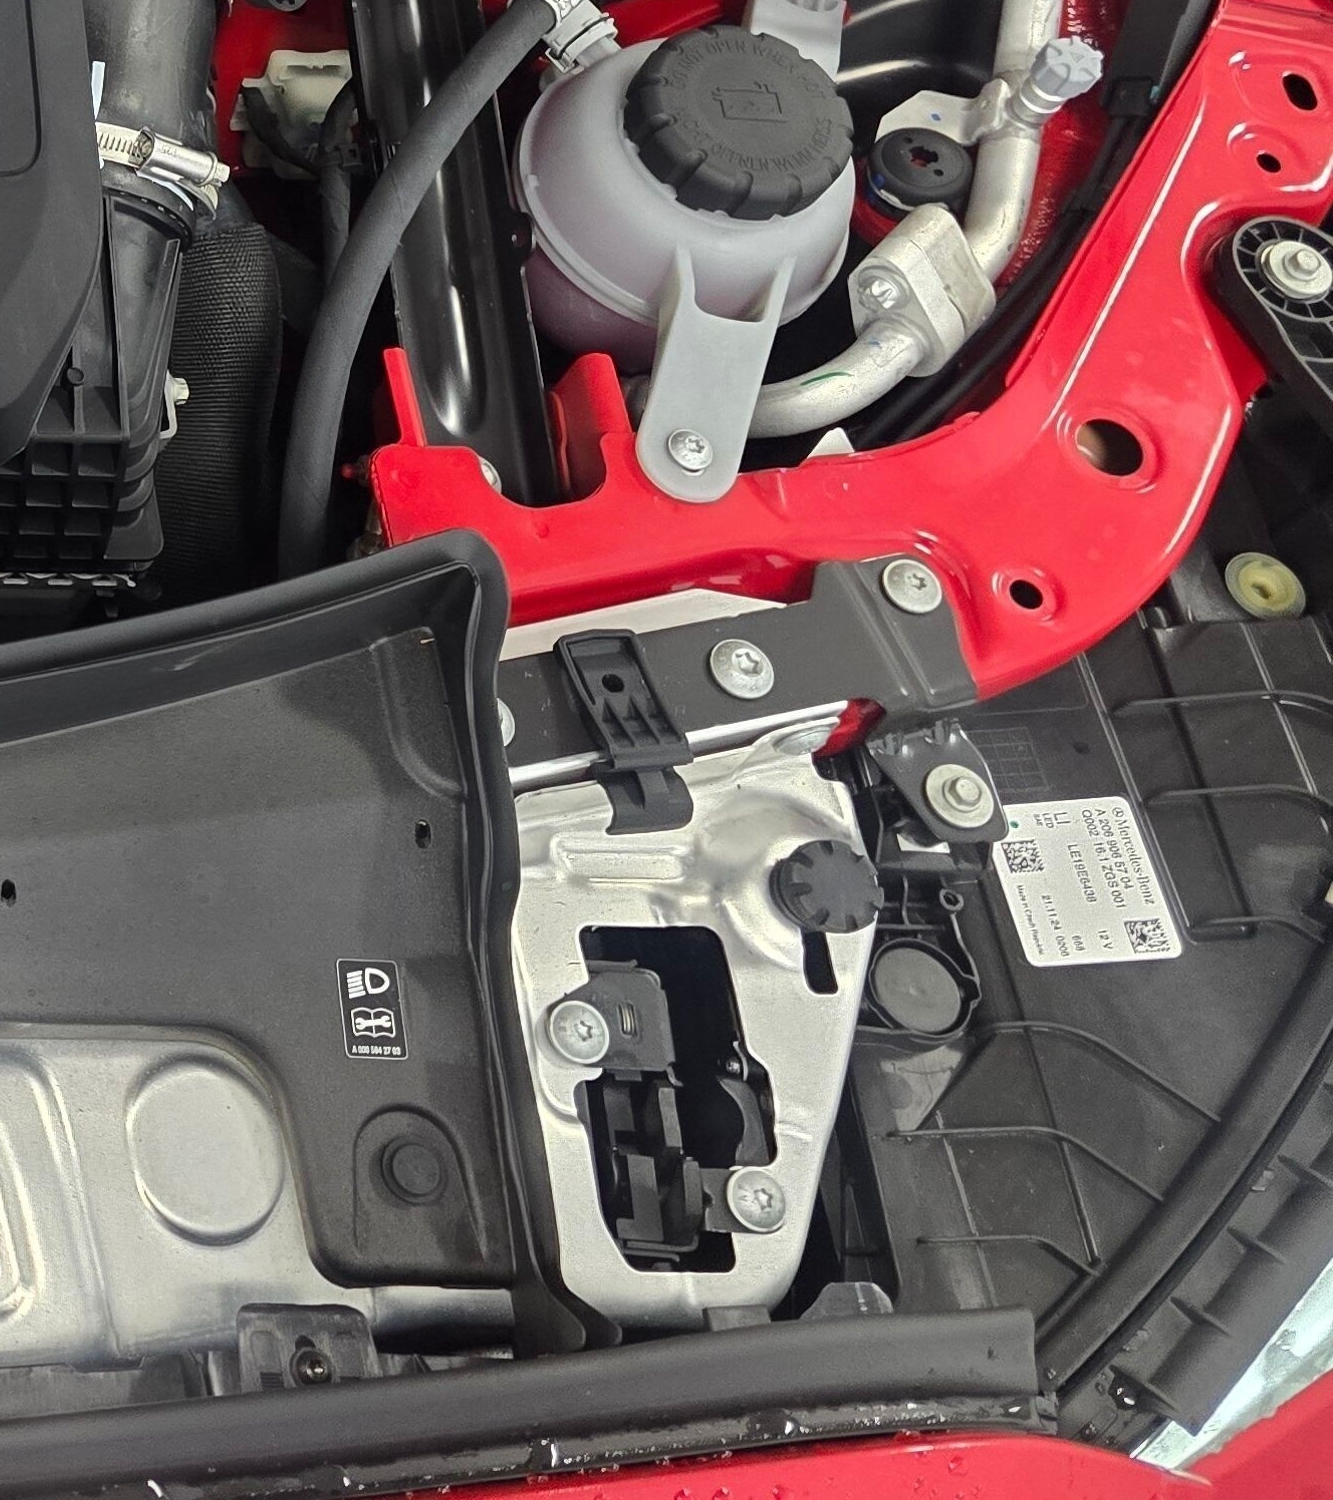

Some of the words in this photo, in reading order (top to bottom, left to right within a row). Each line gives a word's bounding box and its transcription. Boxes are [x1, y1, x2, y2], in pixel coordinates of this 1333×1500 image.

[1042, 812, 1054, 829] LED
[1095, 808, 1106, 817] A
[1099, 818, 1114, 838] 206
[1106, 839, 1121, 860] 906
[1082, 809, 1100, 837] Q002
[1101, 864, 1119, 889] ZGS
[1111, 889, 1126, 908] 001
[1114, 818, 1155, 905] Mercedes-Benz
[1120, 876, 1134, 890] 04
[1103, 941, 1114, 950] V
[352, 1045, 357, 1053] A
